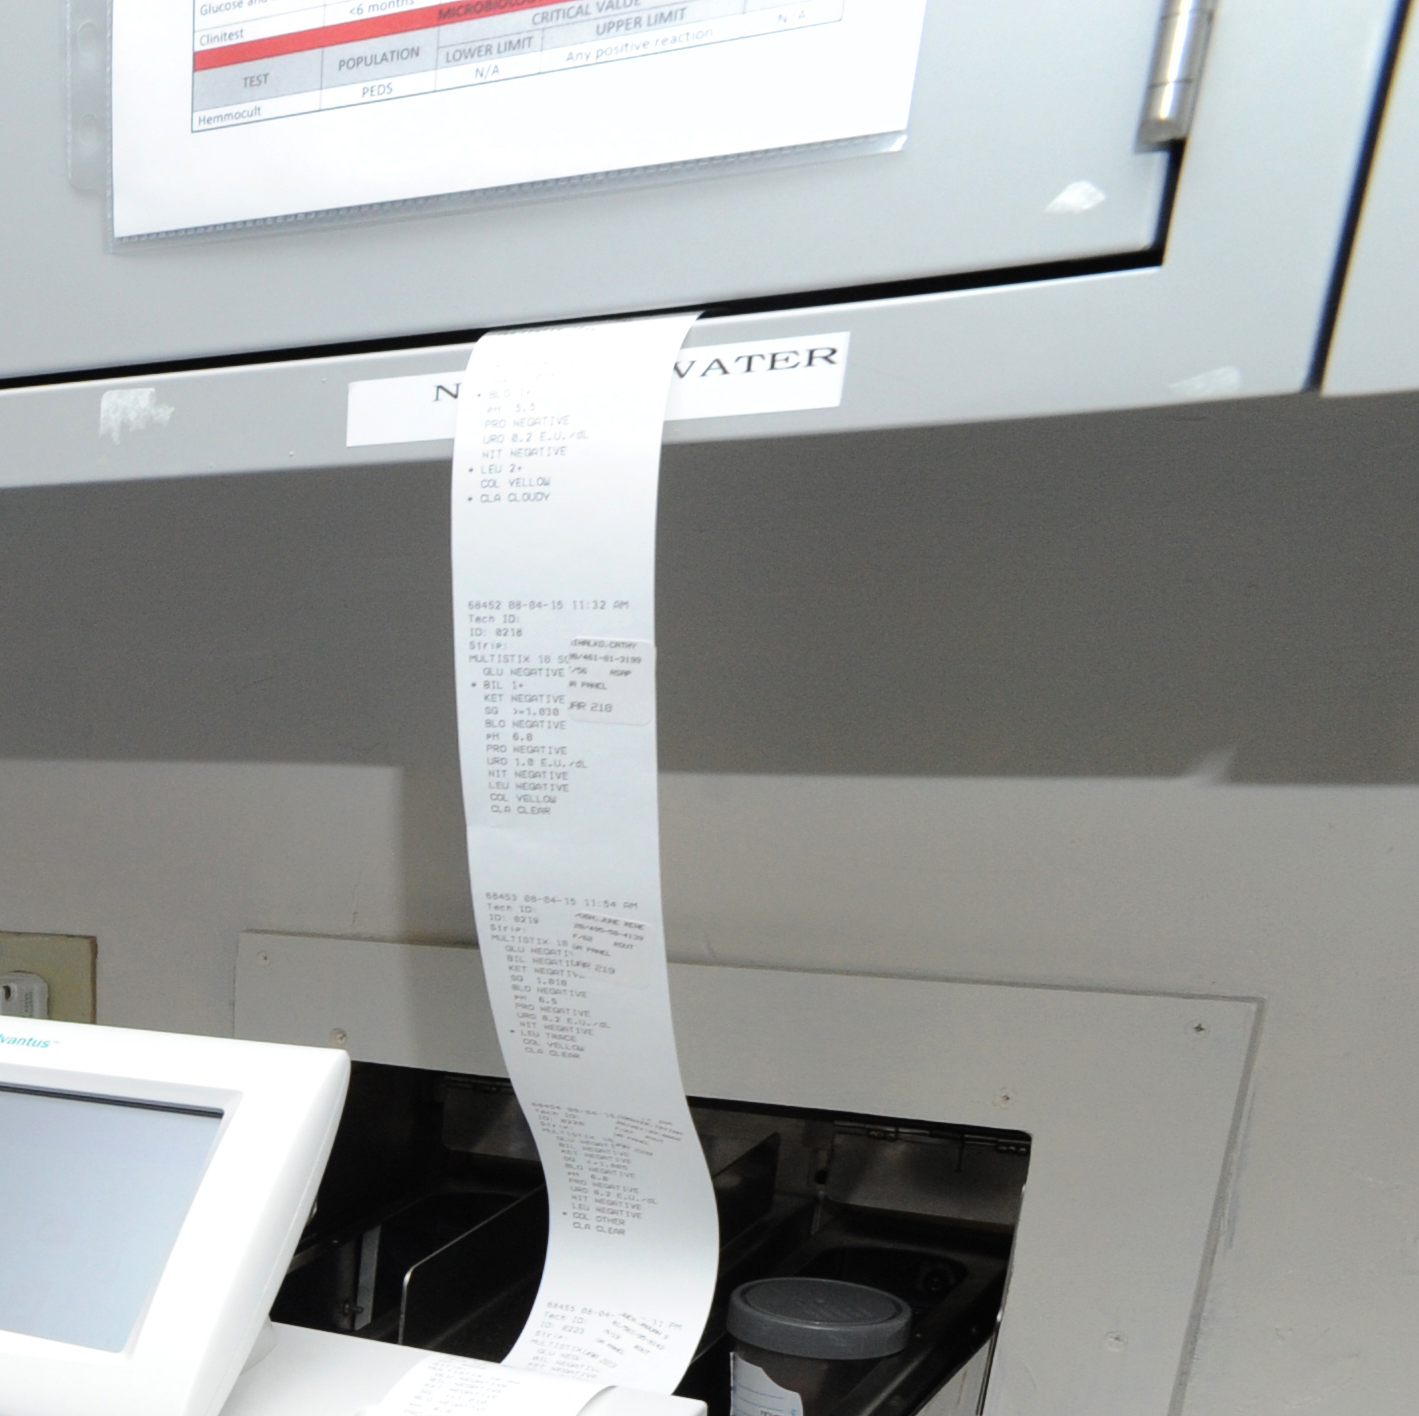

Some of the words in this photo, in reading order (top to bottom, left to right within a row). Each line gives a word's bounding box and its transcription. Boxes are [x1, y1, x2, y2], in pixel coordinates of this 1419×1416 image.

[200, 0, 243, 16] Glucose
[349, 5, 364, 16] <6
[532, 3, 591, 26] CRITICAL
[596, 17, 643, 36] UPPER
[647, 7, 688, 28] LIMIT
[200, 29, 244, 46] Clinitest
[446, 44, 493, 64] LOWER
[497, 36, 534, 55] LIMIT
[566, 50, 591, 63] Any
[596, 39, 651, 63] positive
[654, 28, 714, 48] reaction
[338, 47, 420, 71] POPULATION
[475, 64, 500, 79] N/A
[243, 73, 270, 88] TEST
[362, 82, 393, 98] PEDS
[198, 106, 261, 126] Hemmocult
[513, 415, 570, 428] NEGATIVE
[510, 446, 567, 458] NEGATIVE
[480, 464, 503, 474] LEU
[508, 477, 551, 487] YELLOW
[572, 600, 607, 610] 11:32
[613, 600, 630, 610] AM
[468, 614, 495, 624] Tech
[469, 655, 530, 664] MULTISTIX
[510, 668, 566, 678] NEGATIVE
[483, 680, 504, 690] BIL
[484, 693, 504, 703] KET
[510, 694, 566, 704] NEGATIVE
[485, 719, 506, 729] BLO
[512, 720, 567, 730] NEGATIVE
[486, 744, 507, 754] PRO
[513, 745, 568, 756] NEGATIVE
[487, 757, 508, 766] URO
[488, 769, 507, 779] NIT
[514, 770, 569, 781] NEGATIVE
[488, 781, 510, 790] LEU
[515, 782, 570, 793] NEGATIVE
[516, 793, 557, 804] YELLOW
[517, 805, 552, 815] CLEAR
[595, 1206, 643, 1220] NEGATIVE
